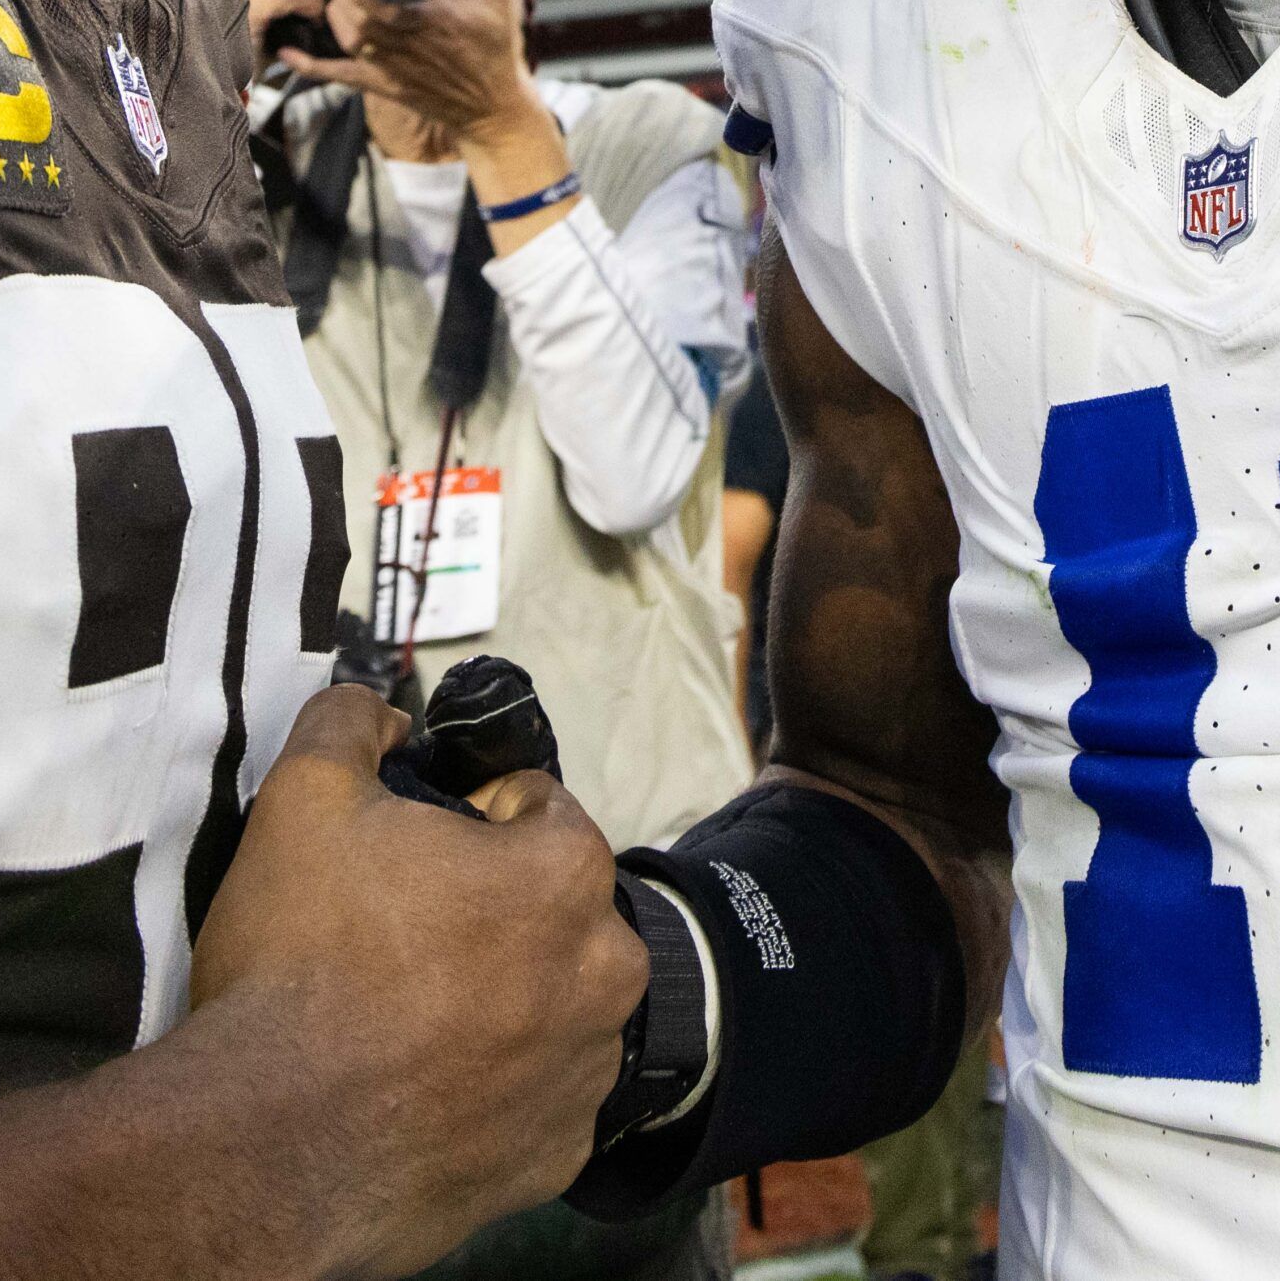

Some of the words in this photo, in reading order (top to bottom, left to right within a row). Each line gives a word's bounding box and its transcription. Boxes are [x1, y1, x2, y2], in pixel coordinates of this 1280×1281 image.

[1189, 185, 1243, 236] NFL
[731, 880, 761, 920] Machine
[758, 891, 774, 911] Dry
[729, 896, 754, 938] LARGE
[751, 921, 761, 934] In
[758, 920, 768, 936] Or
[770, 912, 784, 930] Air
[757, 936, 771, 970] Made
[763, 938, 780, 970] Hand
[766, 926, 782, 954] Cold
[778, 956, 787, 970] In
